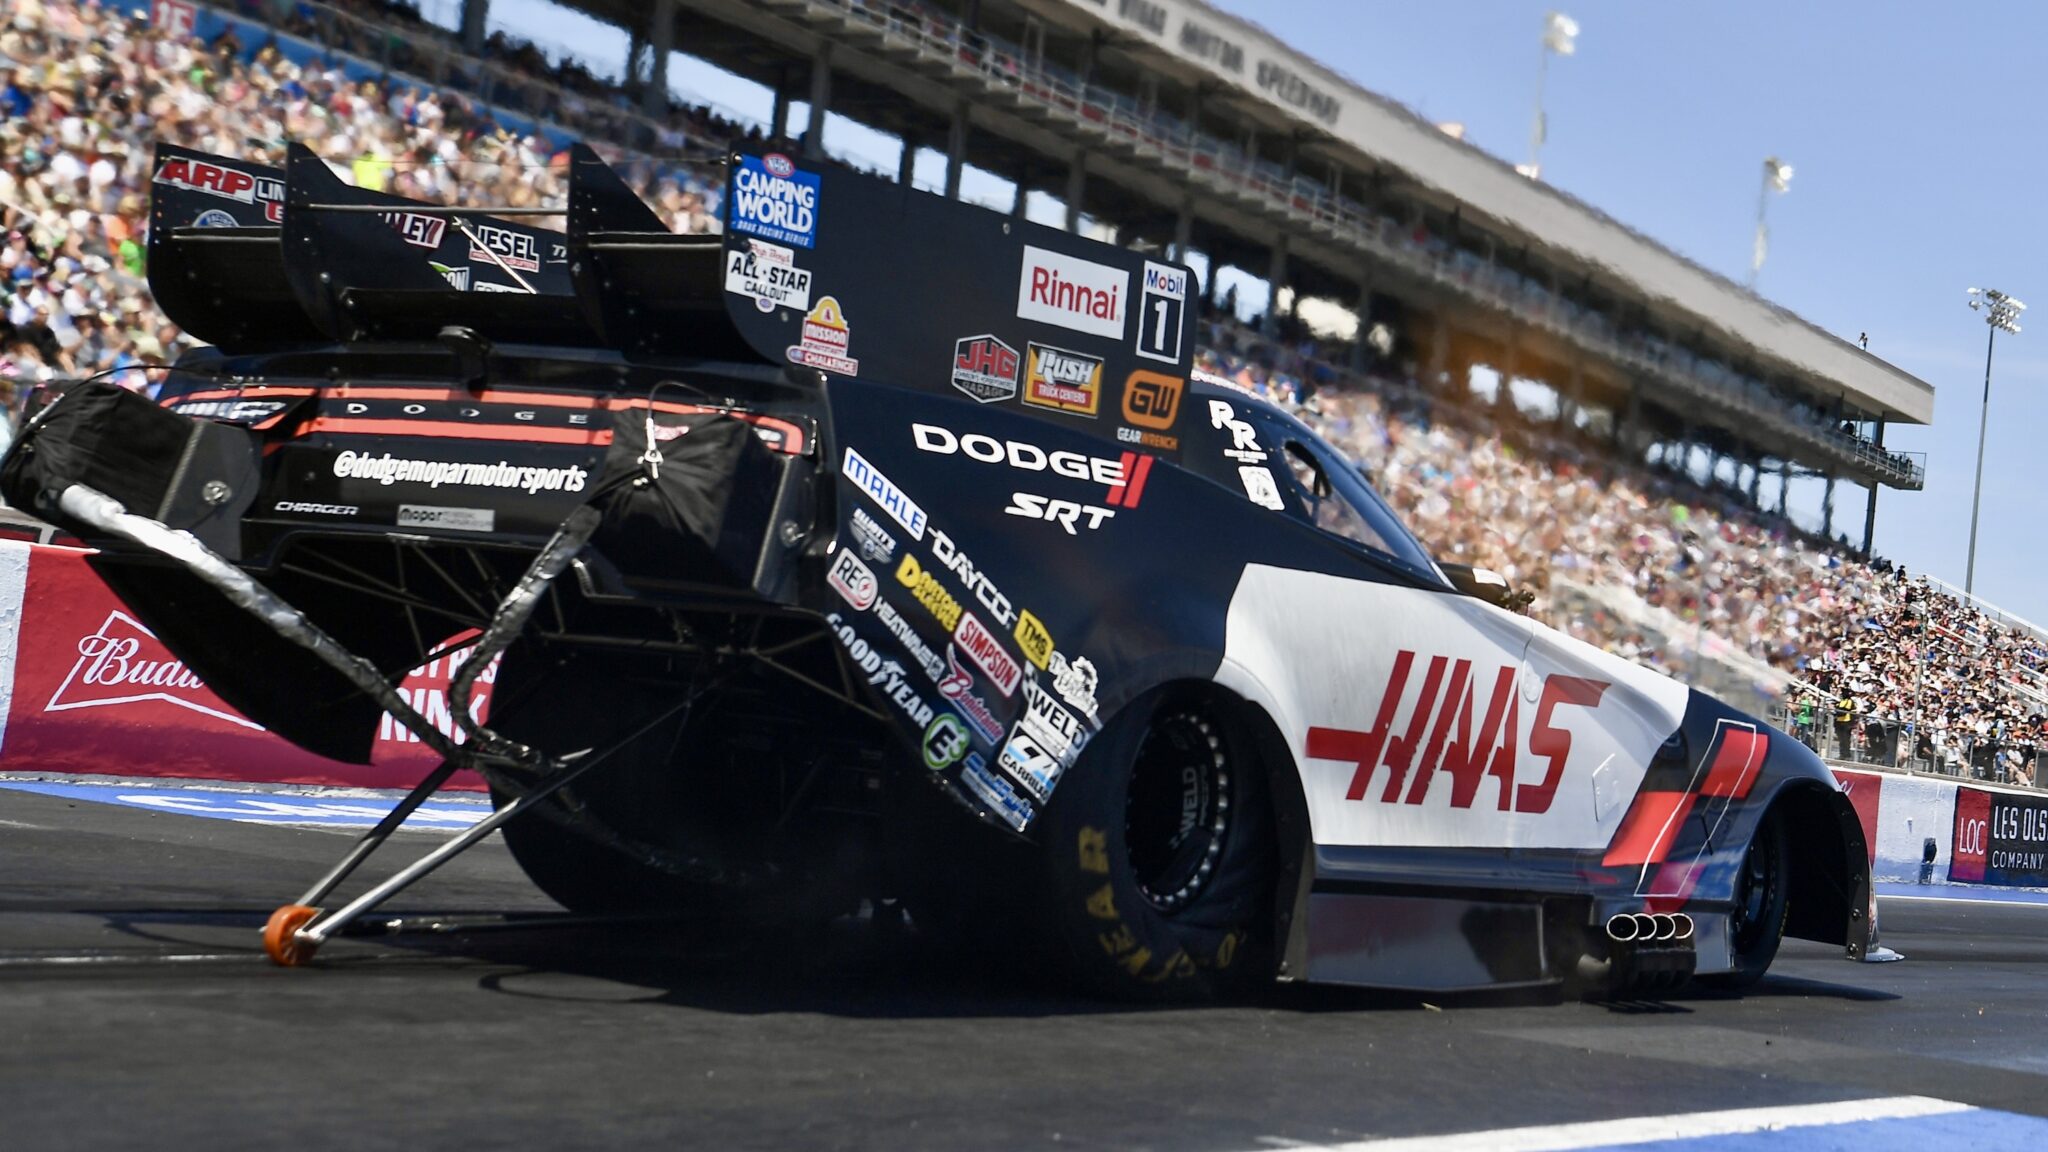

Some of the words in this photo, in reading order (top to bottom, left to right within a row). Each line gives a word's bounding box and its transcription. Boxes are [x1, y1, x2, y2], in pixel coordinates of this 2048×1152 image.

[1257, 58, 1341, 126] SPEEDWAY
[160, 161, 253, 195] ARP
[736, 168, 815, 209] CAMPING
[736, 190, 813, 233] WORLD
[744, 281, 788, 302] CALLOUT
[1031, 263, 1118, 321] Rinnai
[1146, 269, 1184, 295] Mobil
[1154, 300, 1168, 351] 1
[958, 341, 1017, 379] JHG
[347, 403, 588, 424] DODGE
[1038, 384, 1058, 399] TRUCK
[1058, 387, 1087, 404] CENTERS
[333, 450, 588, 495] @dodgemoparmotorsports
[912, 423, 1127, 487] DODGE
[274, 501, 359, 516] CHARGER
[848, 454, 923, 534] MAHLE
[1004, 492, 1116, 535] SRT
[927, 526, 1018, 626] DAYCO
[960, 621, 1017, 689] SIMPSON
[1024, 618, 1048, 656] TMS
[826, 614, 934, 730] GOODYEAR
[1032, 690, 1087, 750] WELD
[1305, 650, 1612, 814] HAAS
[1959, 817, 1986, 856] LOC
[1993, 805, 2019, 840] LES
[2023, 808, 2048, 842] OLS
[1992, 850, 2044, 869] COMPANY
